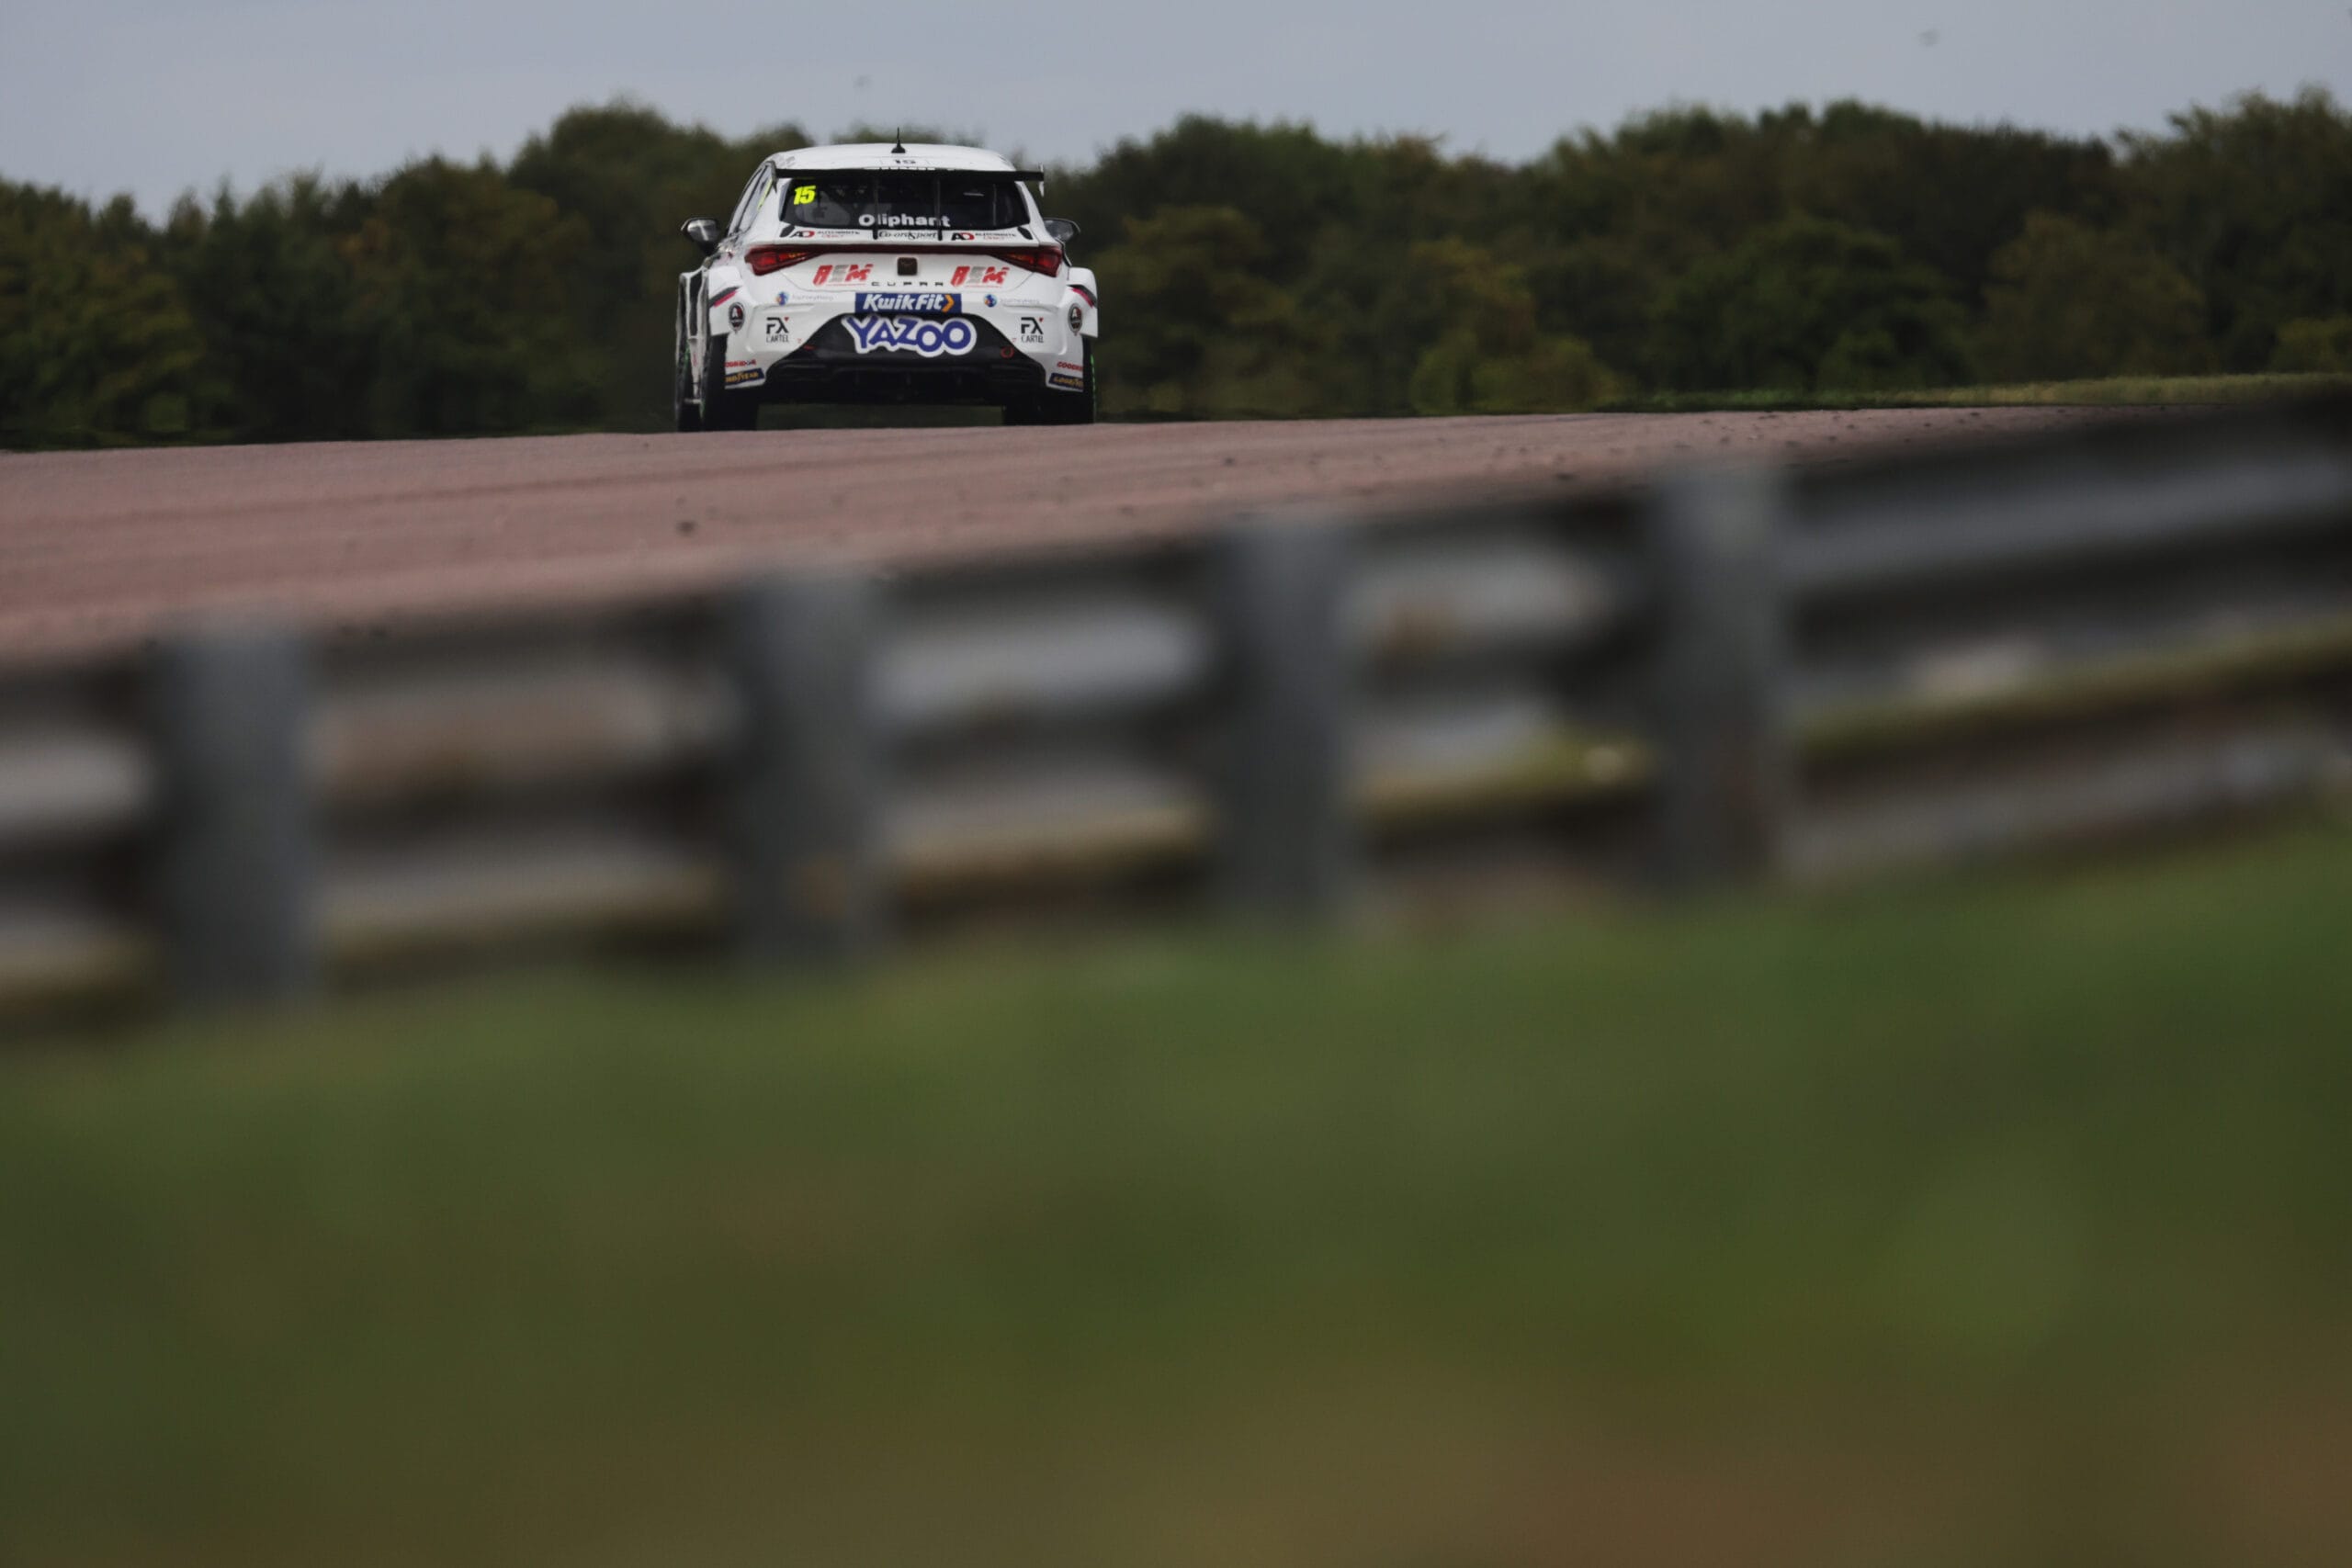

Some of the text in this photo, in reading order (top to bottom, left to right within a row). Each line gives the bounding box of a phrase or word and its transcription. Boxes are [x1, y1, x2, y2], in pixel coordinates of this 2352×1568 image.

[794, 186, 816, 205] 15
[858, 213, 951, 228] Oliphant
[766, 317, 789, 333] FX
[1021, 317, 1044, 334] FX
[766, 334, 789, 343] CARTEL
[842, 314, 976, 356] YAZOO
[1021, 334, 1044, 344] CARTEL
